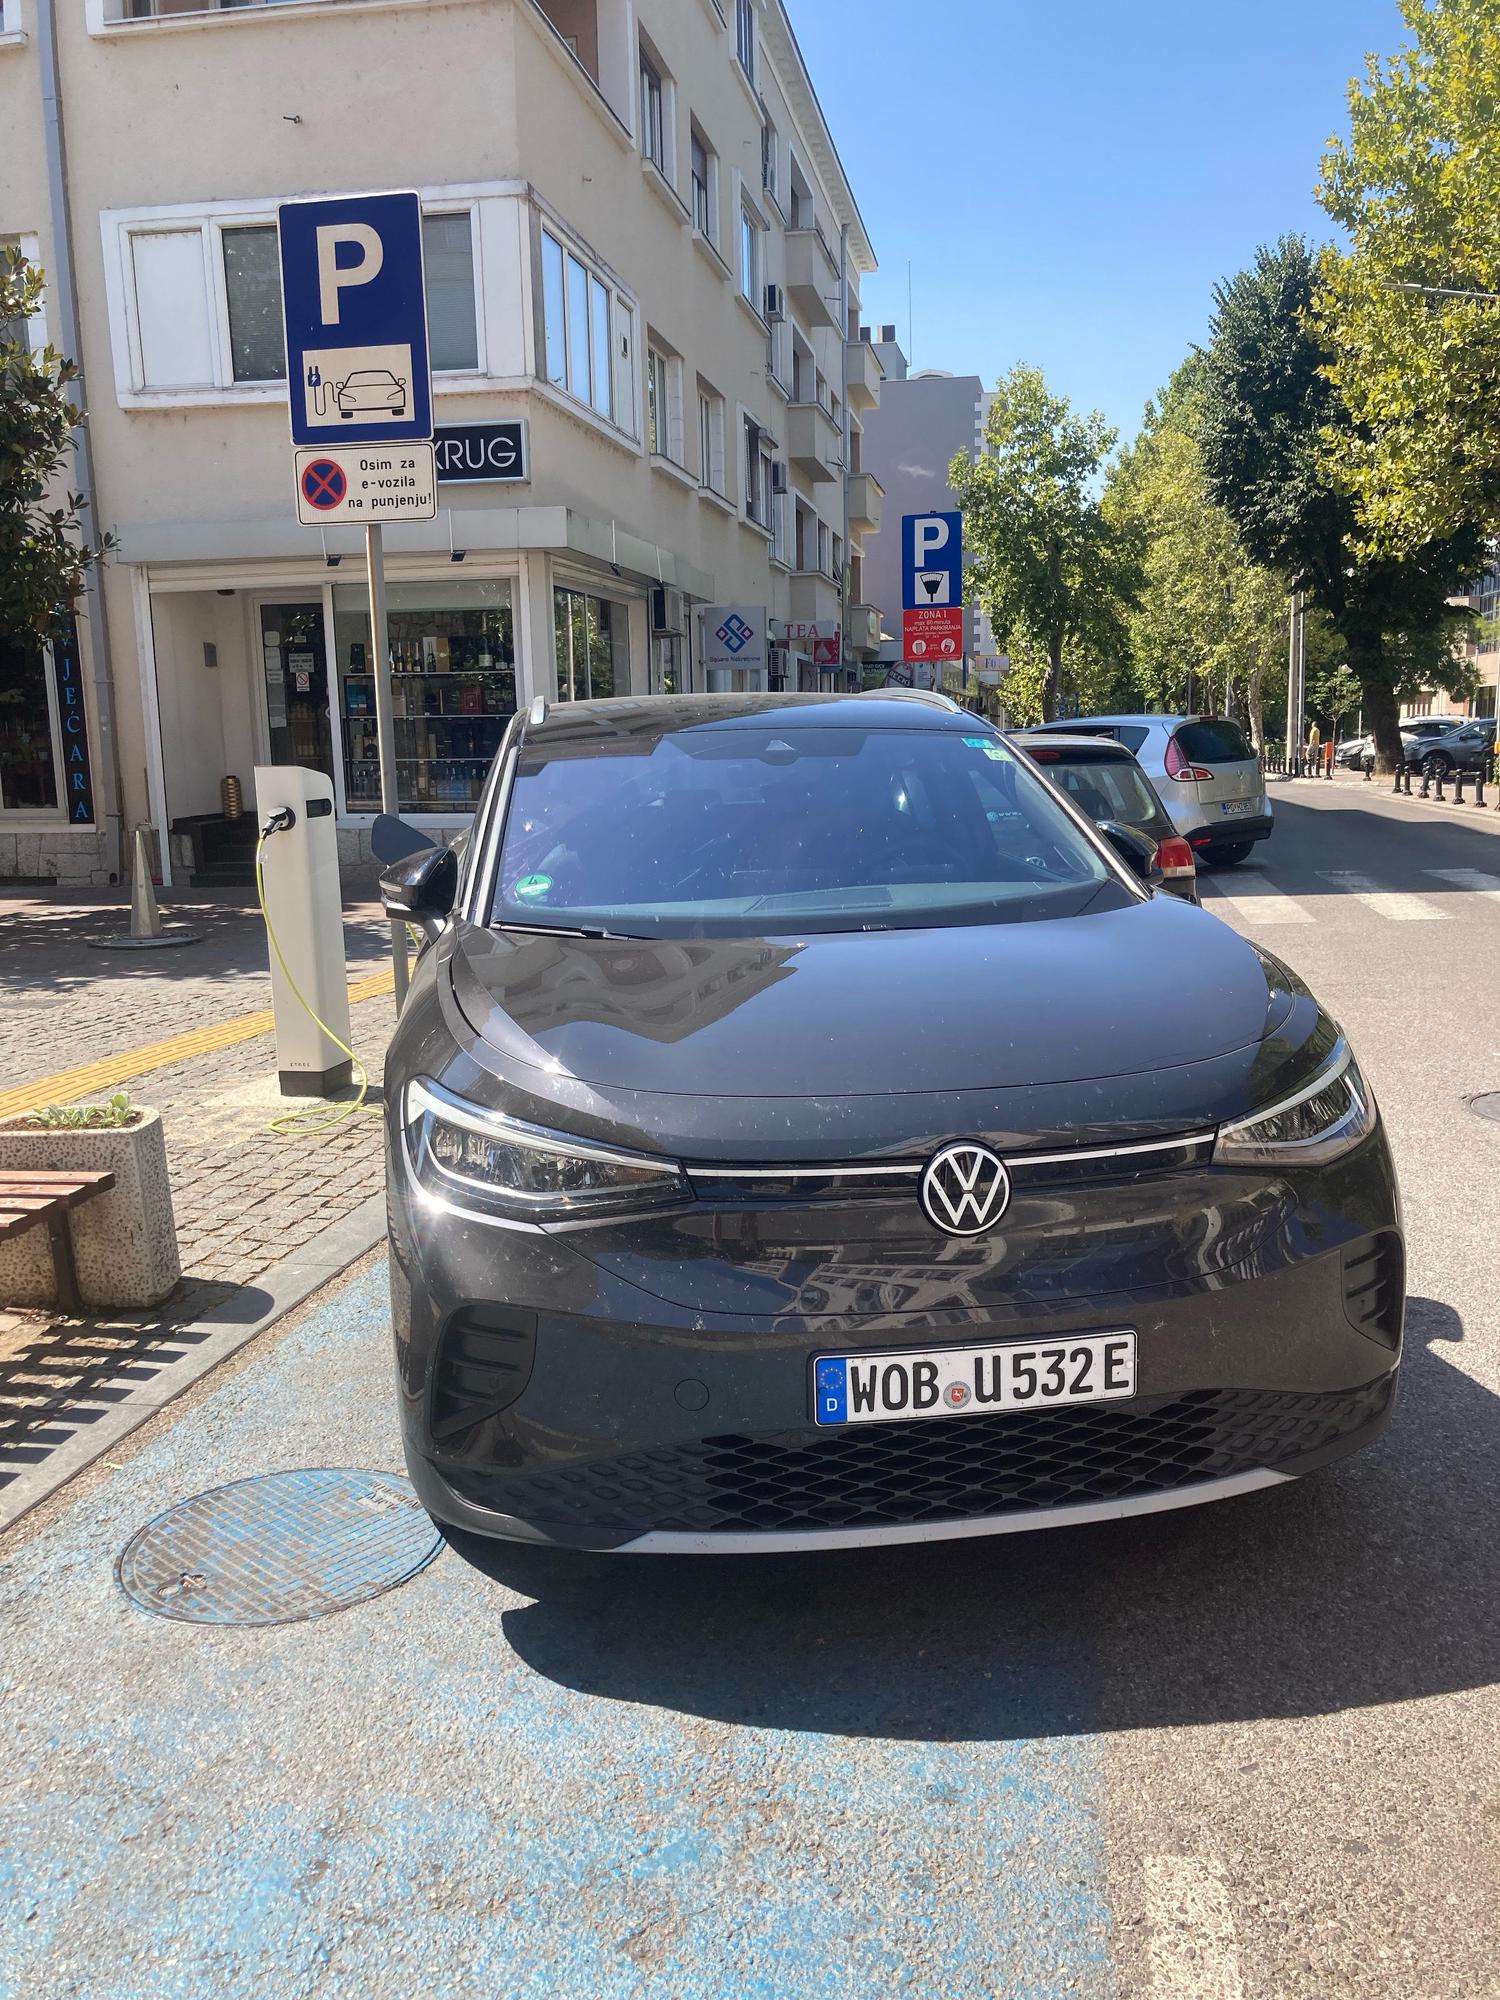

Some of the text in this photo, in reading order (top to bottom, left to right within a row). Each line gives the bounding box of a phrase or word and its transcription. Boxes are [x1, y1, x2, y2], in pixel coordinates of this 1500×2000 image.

[315, 223, 384, 326] P
[360, 459, 416, 471] Osim za
[361, 476, 416, 489] e-vozila
[348, 493, 432, 510] na punjenju!
[914, 517, 950, 568] P
[918, 610, 942, 619] ZONA
[783, 623, 820, 639] TEA
[850, 1361, 940, 1413] WOB
[826, 1398, 838, 1412] D
